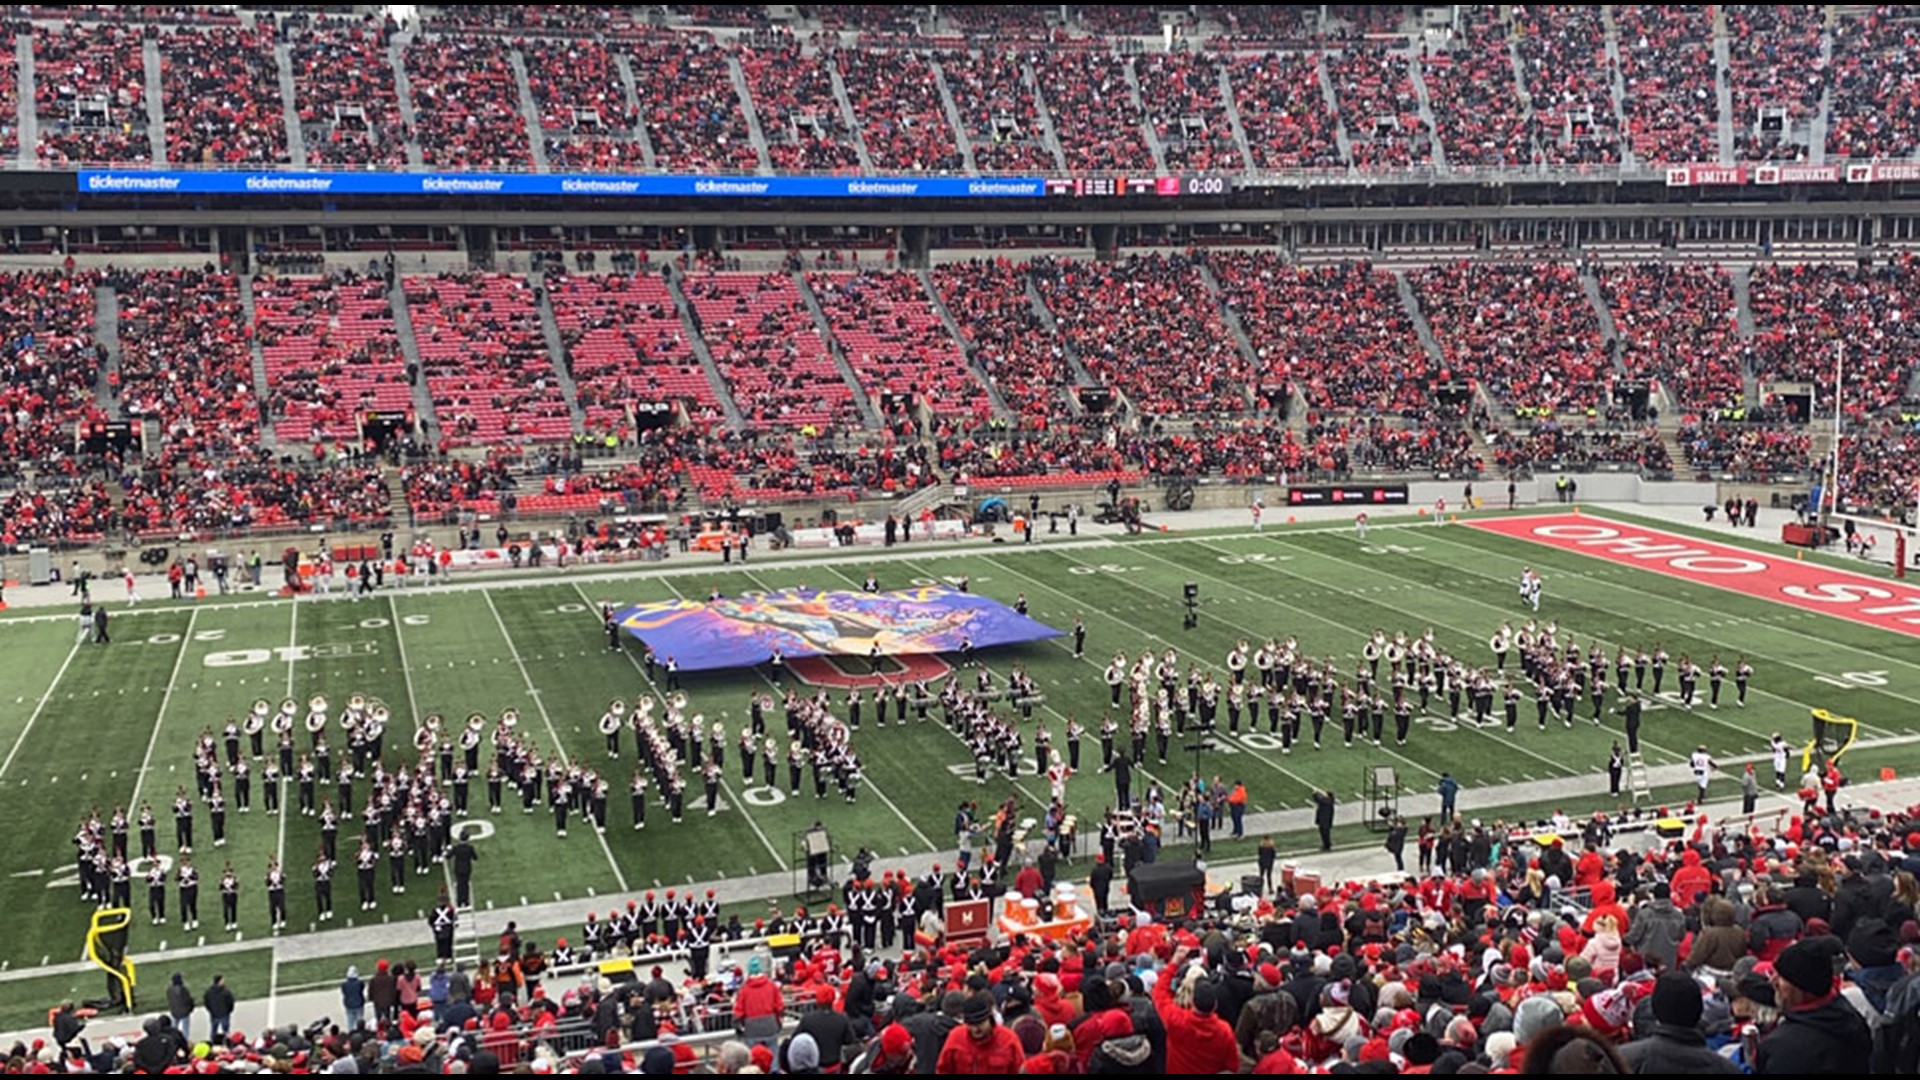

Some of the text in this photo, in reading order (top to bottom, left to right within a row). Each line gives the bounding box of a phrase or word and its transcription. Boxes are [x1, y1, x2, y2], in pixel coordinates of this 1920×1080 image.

[1671, 170, 1738, 184] 10 SMITH
[1759, 170, 1775, 182] 22
[1850, 168, 1868, 181] 27
[89, 176, 180, 189] ticketmaster
[246, 176, 332, 190] ticketmaster
[422, 177, 503, 194] ticketmaster
[562, 179, 639, 192] ticketmaster
[695, 180, 769, 193] ticketmaster
[848, 181, 918, 194] ticketmaster
[969, 182, 1037, 194] ticketmaster
[1189, 178, 1223, 194] 0:00
[1532, 525, 1769, 574] OHIO
